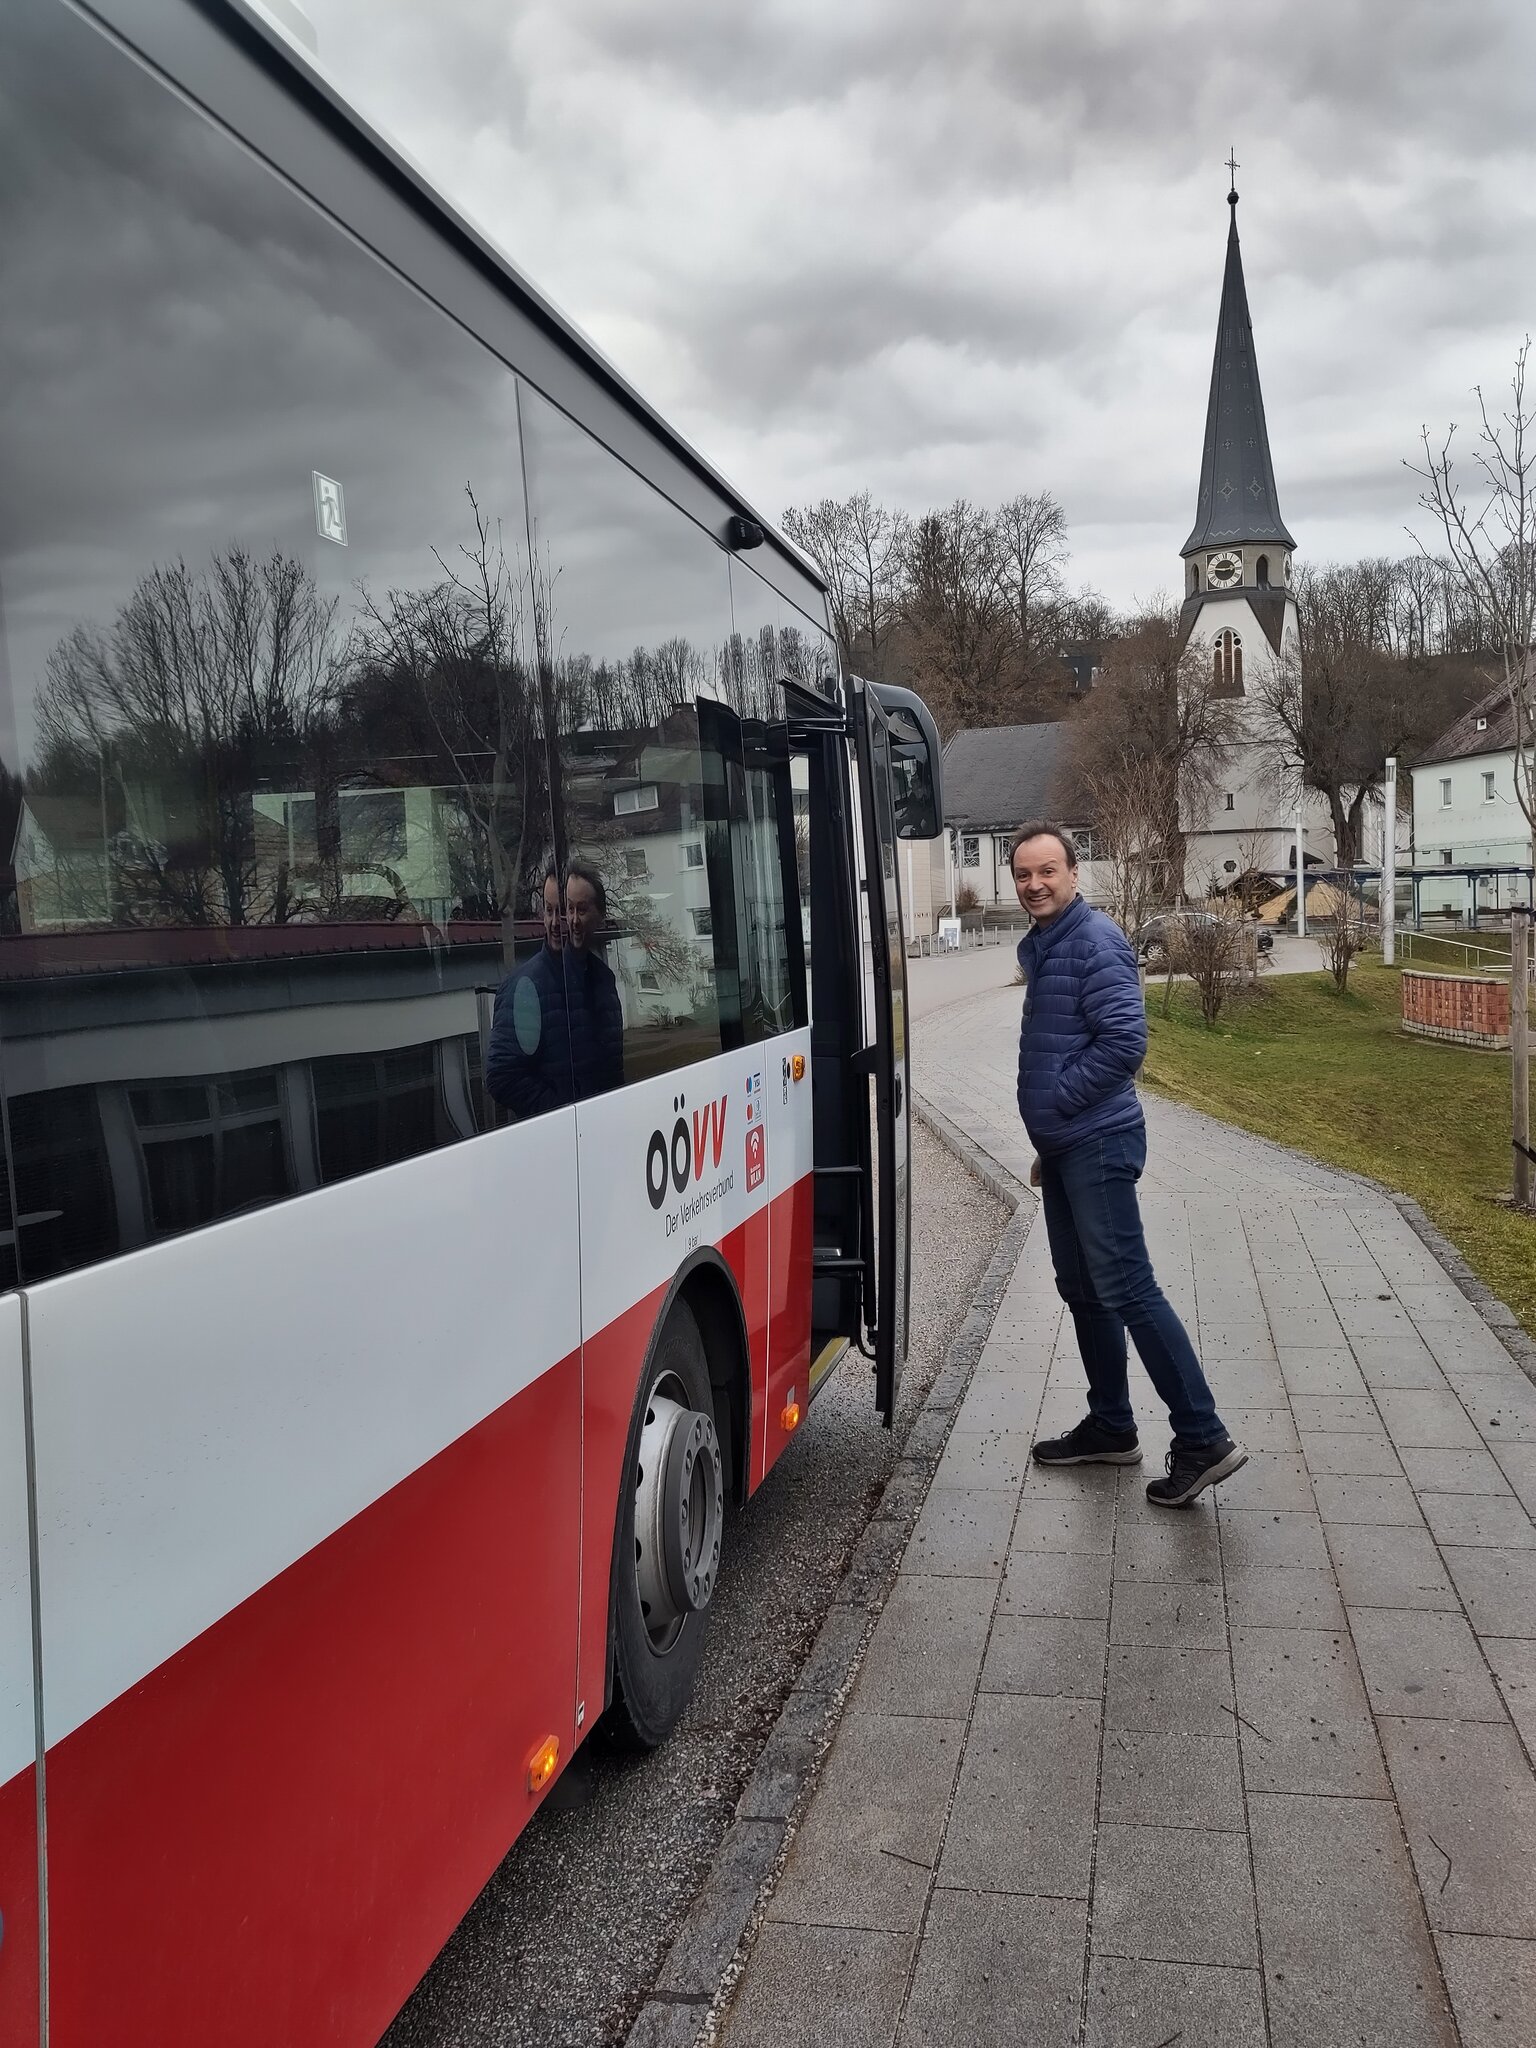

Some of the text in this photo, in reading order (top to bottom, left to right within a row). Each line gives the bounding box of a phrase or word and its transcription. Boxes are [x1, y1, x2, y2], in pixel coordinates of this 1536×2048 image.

[646, 1093, 728, 1210] OÖVV
[665, 1170, 734, 1239] Der Verkehrsverbund
